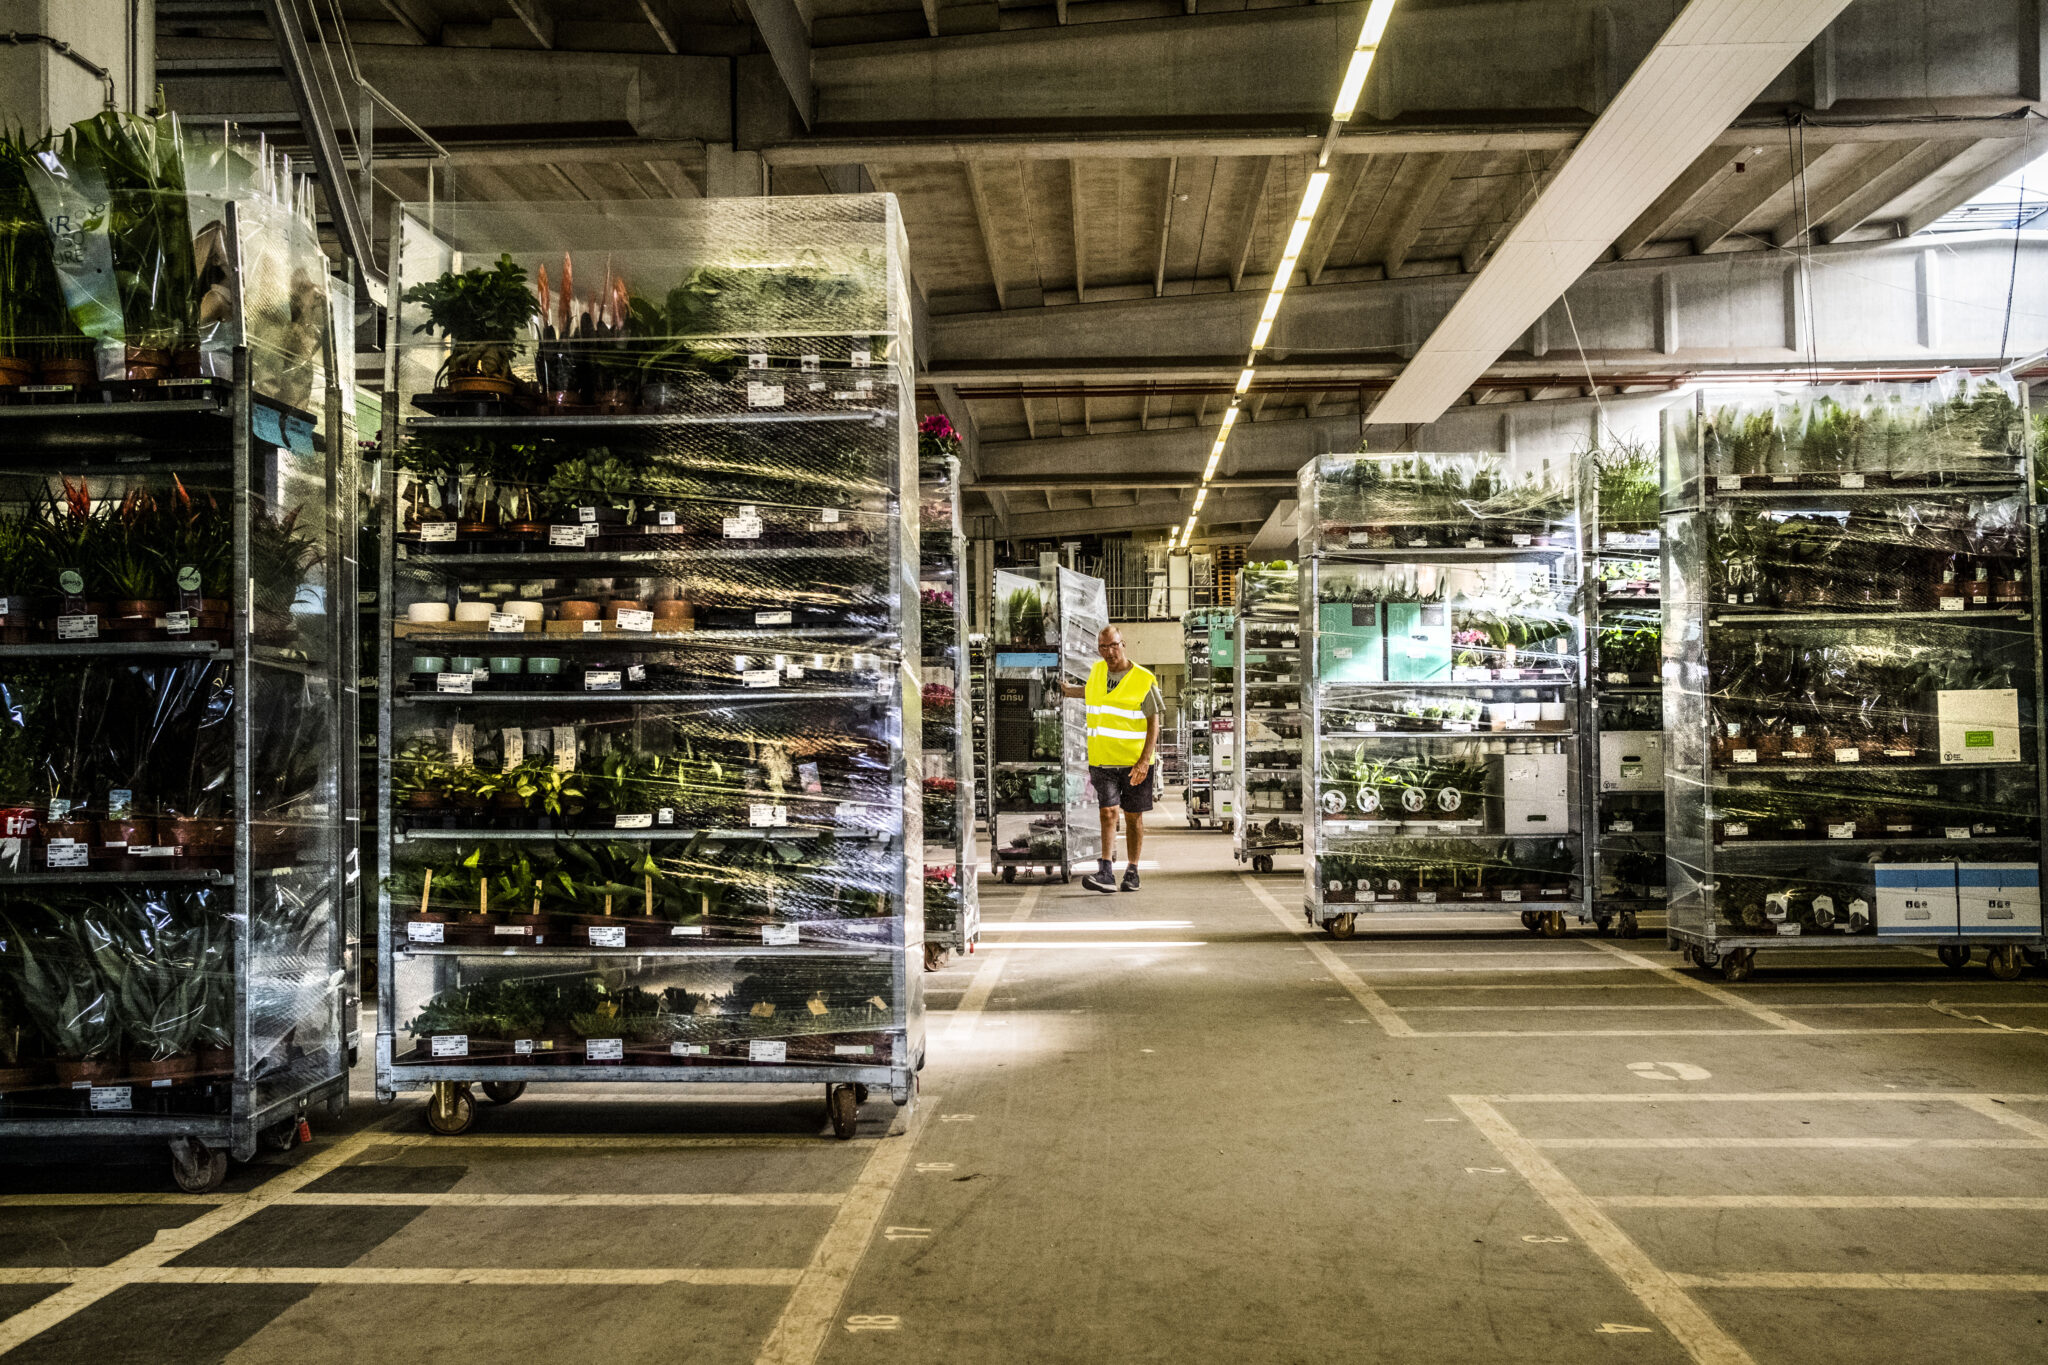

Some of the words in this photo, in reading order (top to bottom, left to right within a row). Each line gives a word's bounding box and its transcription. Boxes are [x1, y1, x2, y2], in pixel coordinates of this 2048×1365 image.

[915, 1162, 956, 1172] 16
[884, 1226, 932, 1240] 17
[843, 1315, 900, 1333] 18
[1594, 1323, 1653, 1333] 4
